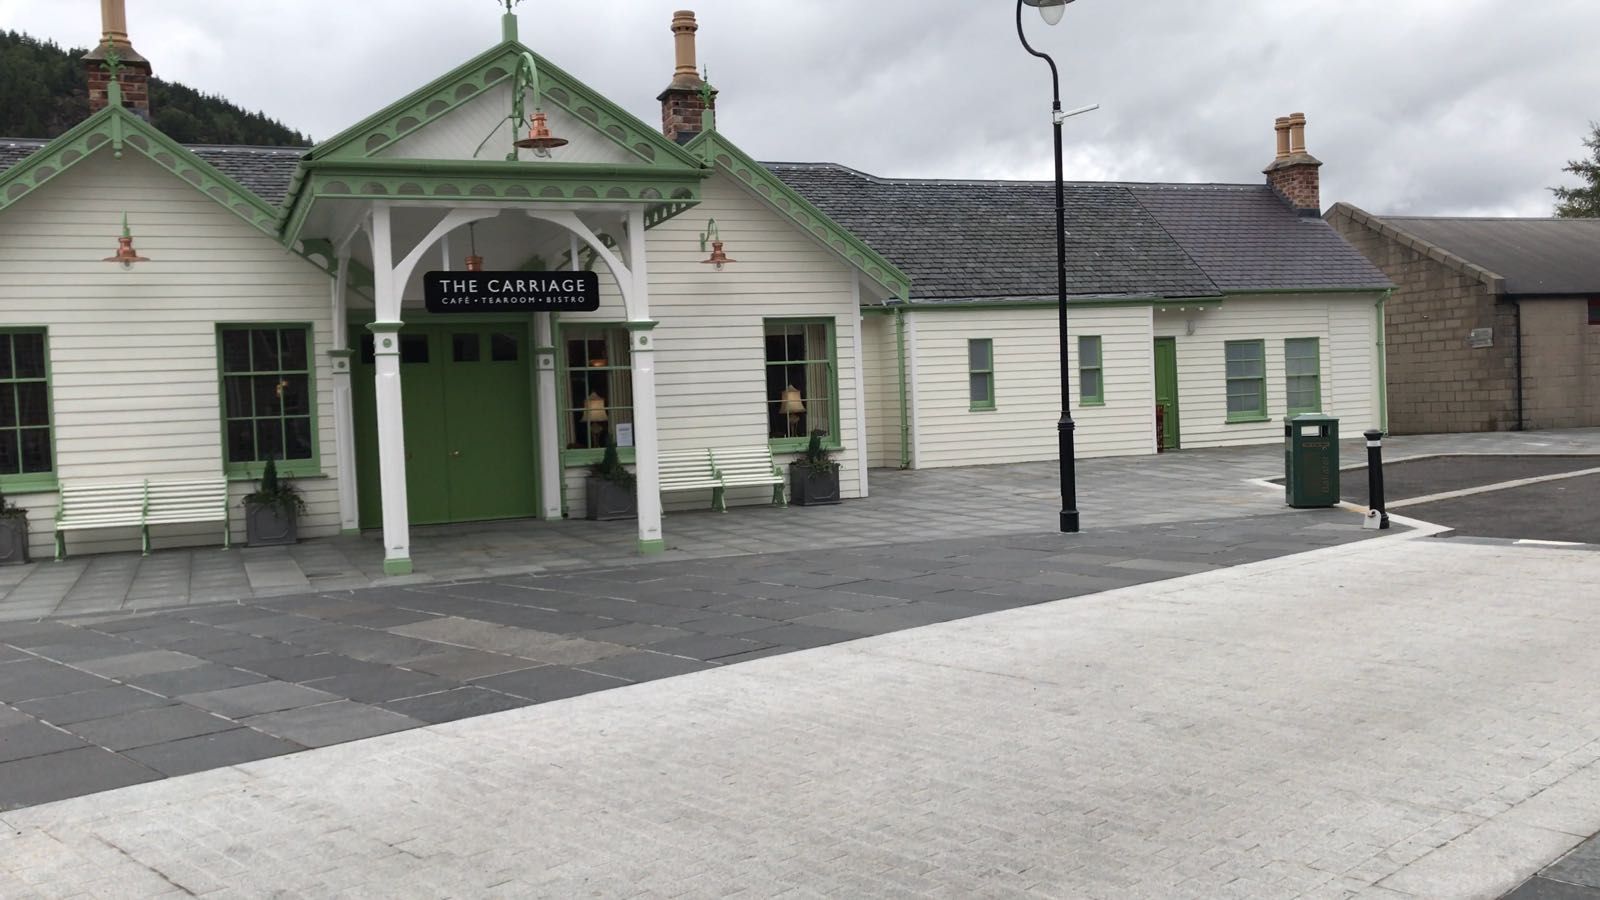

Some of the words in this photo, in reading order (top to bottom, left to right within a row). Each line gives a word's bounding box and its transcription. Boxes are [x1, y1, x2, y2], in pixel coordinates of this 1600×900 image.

[439, 280, 478, 293] THE
[487, 279, 586, 293] CARRIAGE
[441, 296, 470, 305] CAFÉ
[481, 296, 536, 304] TEAROOM
